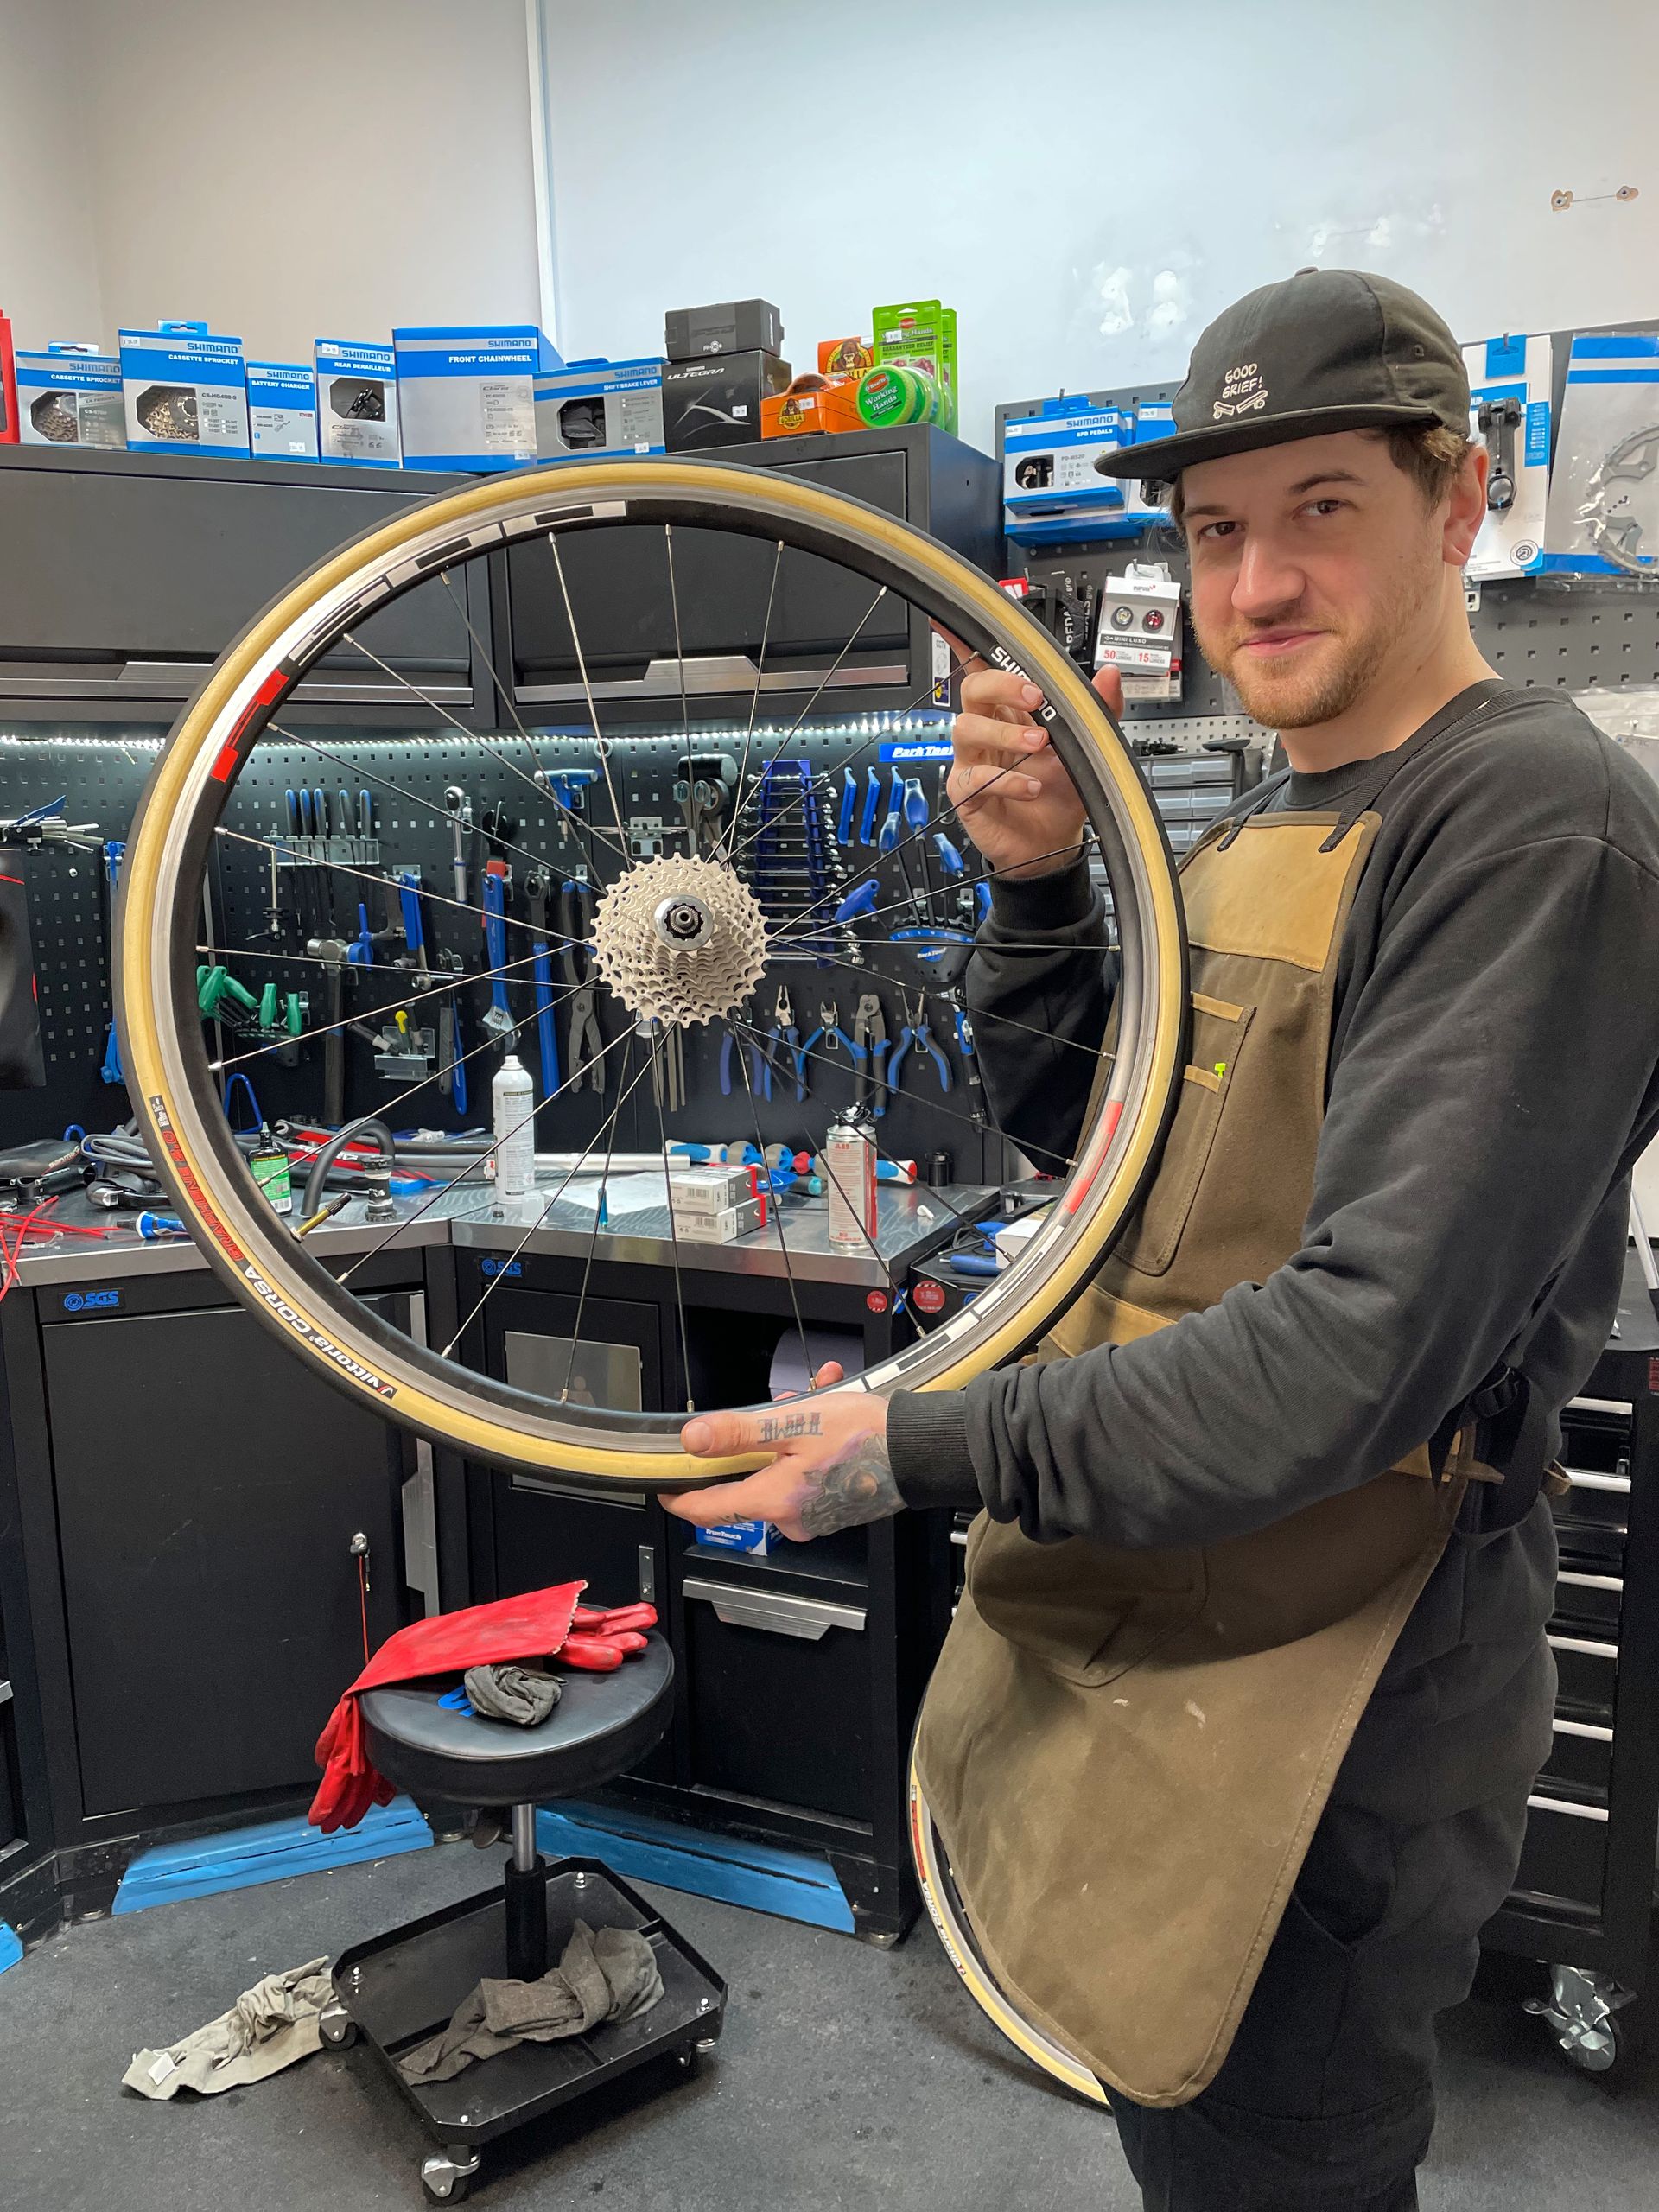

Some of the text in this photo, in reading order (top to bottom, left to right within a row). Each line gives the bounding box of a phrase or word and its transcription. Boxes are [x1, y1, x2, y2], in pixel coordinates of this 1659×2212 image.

[187, 343, 238, 353] SHIMANO
[168, 353, 202, 362] CASSETTE
[342, 350, 391, 361] SHIMANO
[69, 363, 120, 373] SHIMANO
[614, 366, 657, 378] SHIMANO
[667, 368, 725, 380] ULTEGRA
[1224, 363, 1258, 384] GOOD
[267, 371, 309, 380] SHIMANO
[1222, 376, 1263, 399] GRIEF!
[865, 385, 898, 405] Working
[873, 395, 897, 411] Hands
[780, 415, 804, 423] GORILLA
[1066, 416, 1114, 428] SHIMANO
[1103, 650, 1116, 659] 50
[1139, 652, 1149, 663] 15
[990, 646, 1057, 721] SHINO
[177, 1166, 244, 1262] GRAPHENE
[244, 1265, 311, 1333] CORSA
[705, 1528, 742, 1541] TrueTouch
